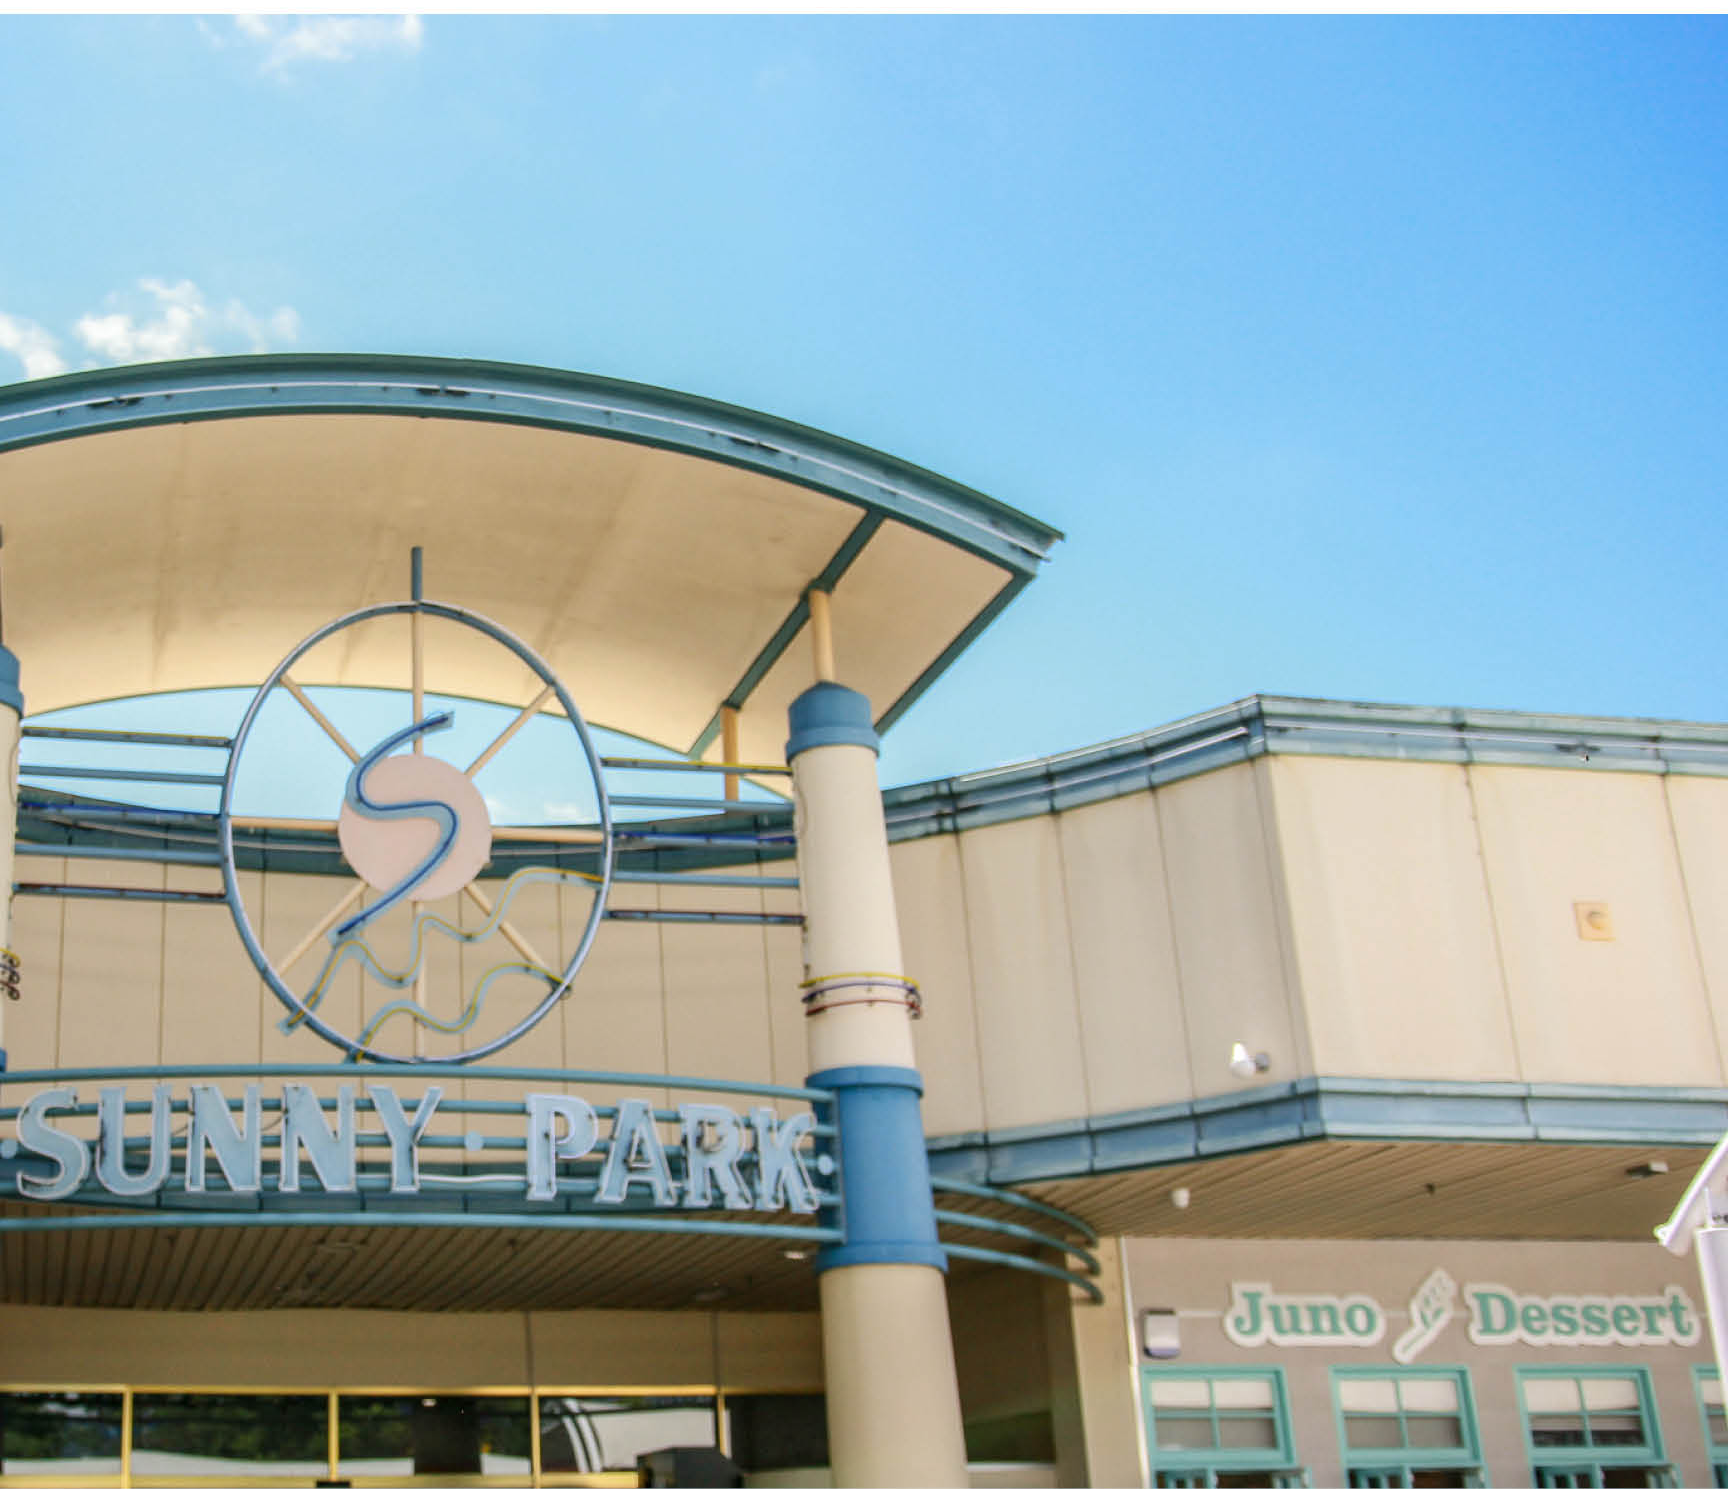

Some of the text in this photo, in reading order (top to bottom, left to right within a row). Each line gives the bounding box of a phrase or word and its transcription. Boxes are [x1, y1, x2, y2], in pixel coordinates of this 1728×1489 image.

[16, 1083, 820, 1214] SUNNY PARK
[1234, 1291, 1694, 1337] Juno Dessert
